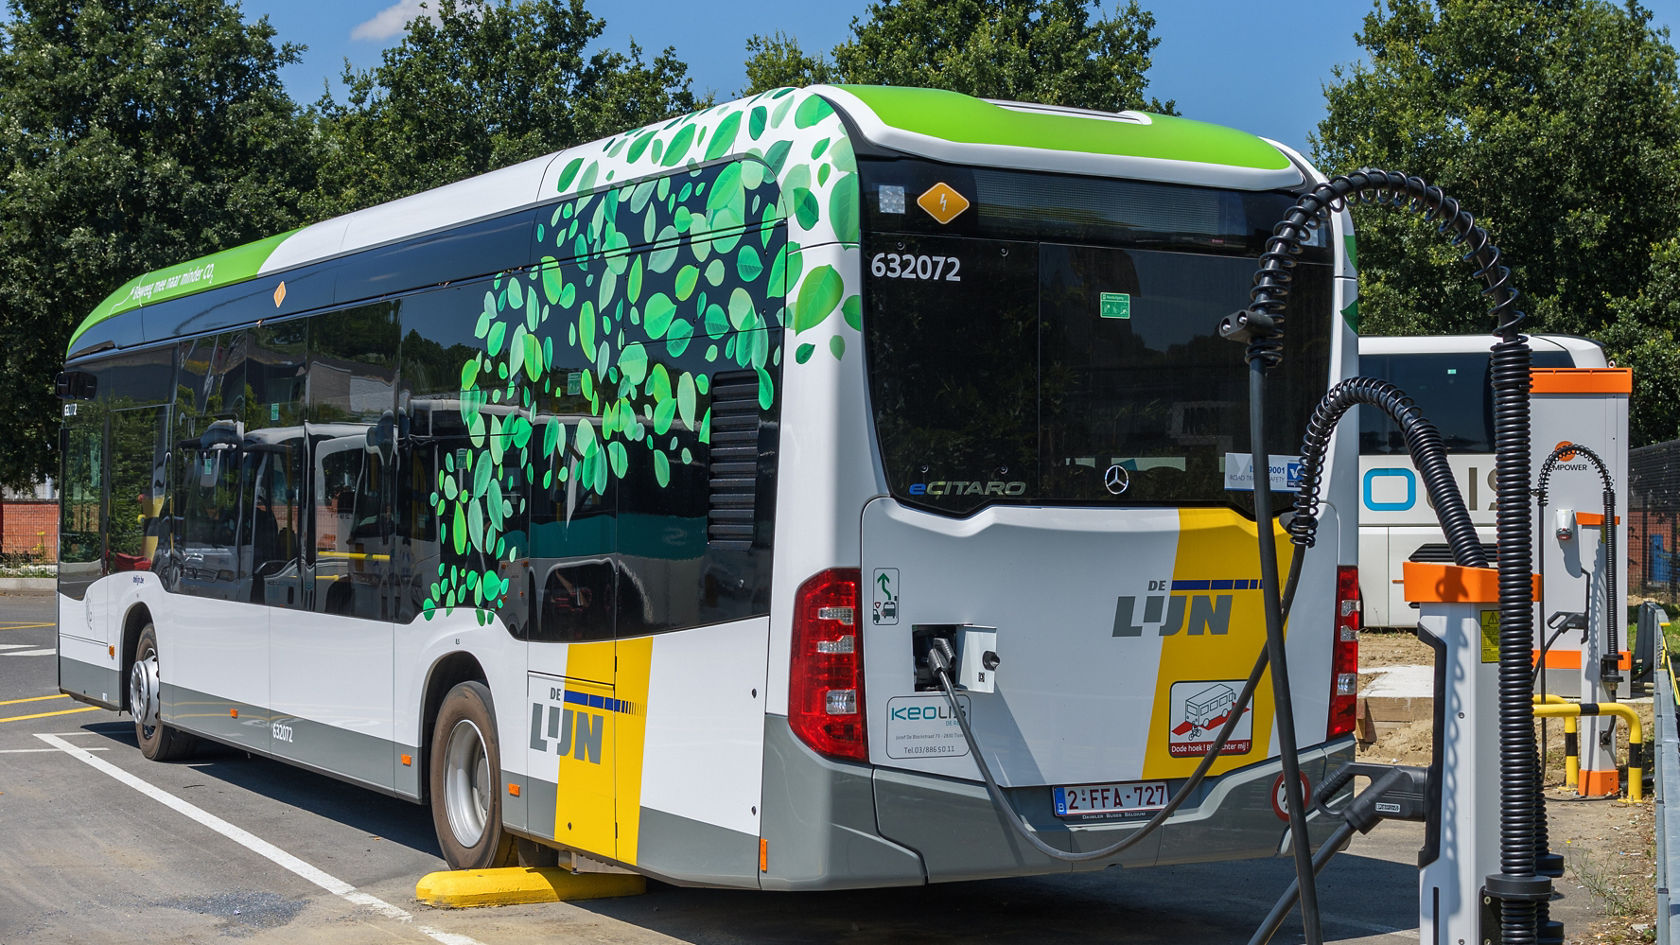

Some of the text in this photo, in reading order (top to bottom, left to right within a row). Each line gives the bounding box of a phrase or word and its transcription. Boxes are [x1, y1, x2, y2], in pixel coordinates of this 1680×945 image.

[871, 252, 961, 282] 632072
[154, 280, 166, 293] mee
[166, 275, 181, 288] naar
[180, 266, 203, 285] minder
[909, 481, 1026, 496] eCITARO
[1148, 580, 1167, 591] DE
[1112, 595, 1233, 637] LIJN
[550, 687, 562, 701] DE
[273, 723, 293, 743] 632072
[530, 702, 604, 765] LIJN
[1188, 744, 1202, 752] hoek
[1058, 803, 1065, 813] B
